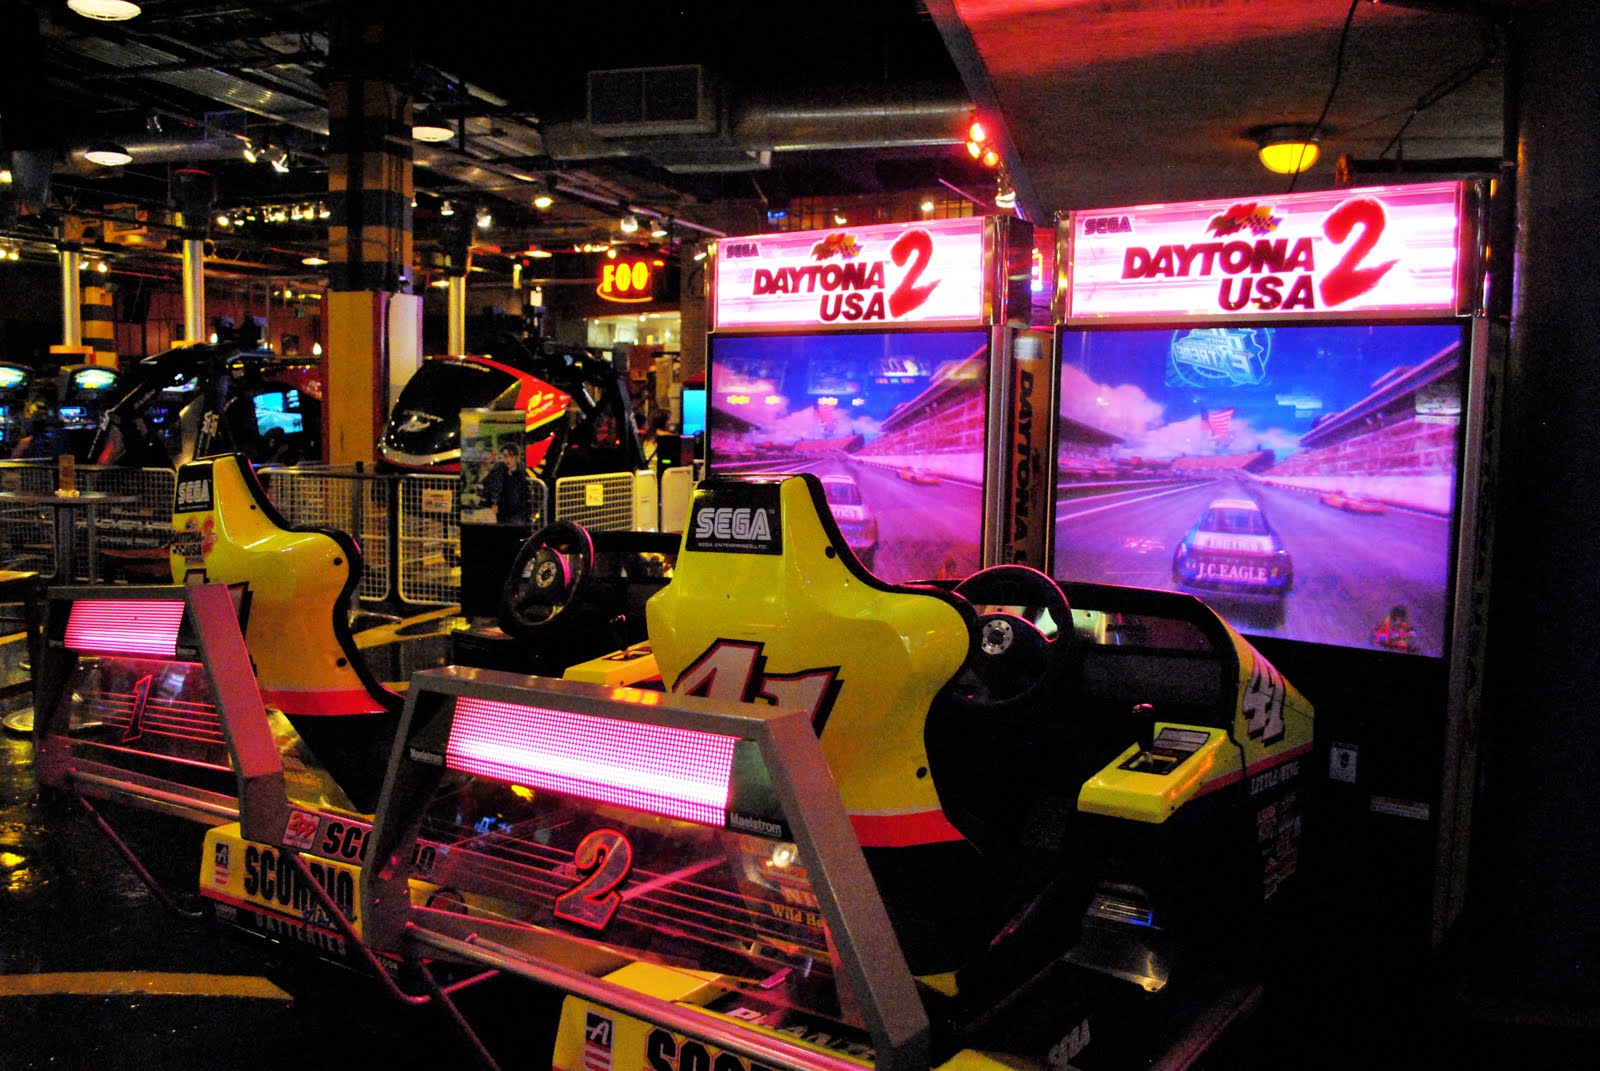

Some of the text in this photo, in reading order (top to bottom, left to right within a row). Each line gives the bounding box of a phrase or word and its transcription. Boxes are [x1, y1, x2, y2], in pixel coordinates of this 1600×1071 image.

[1084, 216, 1132, 234] SEGA
[726, 243, 759, 259] SEGA
[1121, 199, 1400, 307] DAYTONA 2
[603, 261, 664, 293] FOO
[752, 230, 942, 318] DAYTONA 2
[819, 291, 886, 321] USA
[1218, 275, 1315, 310] USA
[1014, 369, 1034, 540] DAYTONA
[177, 479, 210, 504] SEGA
[695, 507, 772, 541] SEGA
[730, 812, 782, 835] Maelstrom
[554, 828, 633, 931] 2
